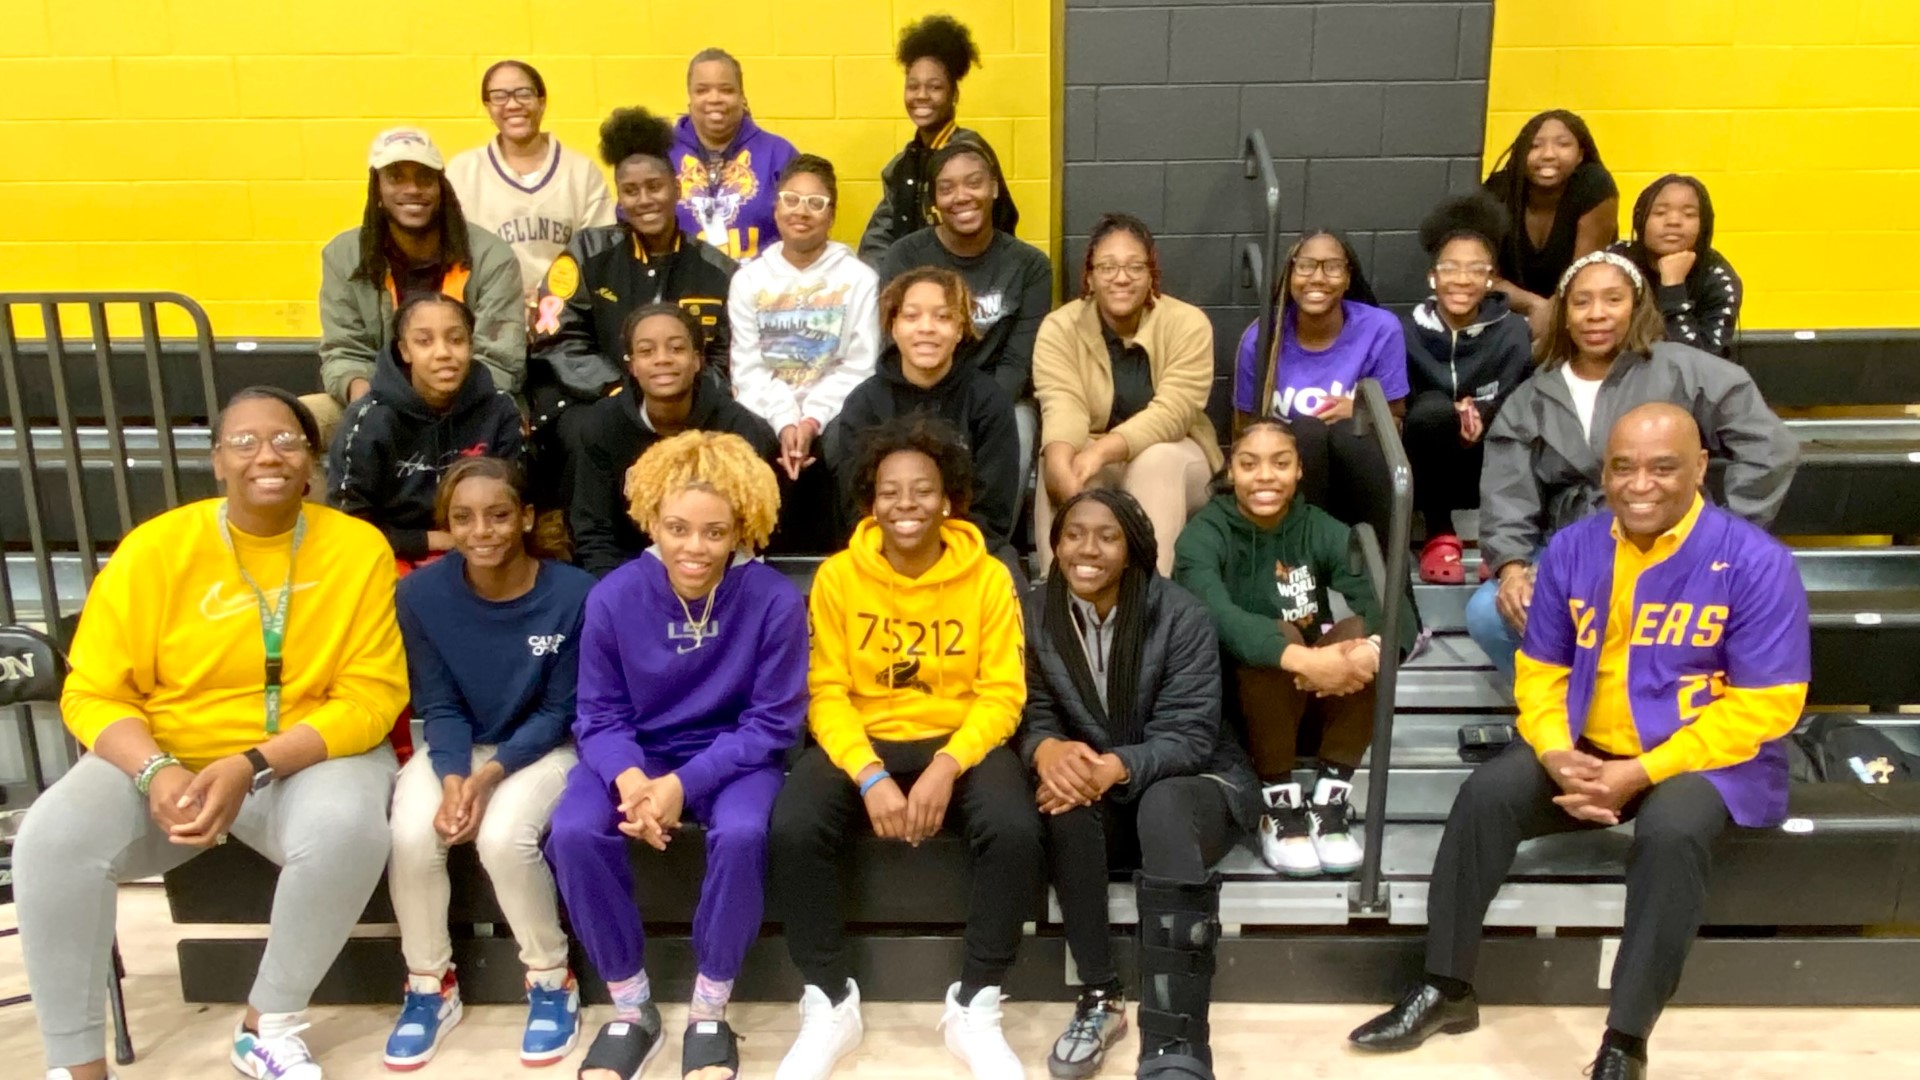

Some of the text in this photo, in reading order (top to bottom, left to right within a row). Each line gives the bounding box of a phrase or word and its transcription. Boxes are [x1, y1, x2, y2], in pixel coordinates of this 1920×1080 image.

[497, 216, 573, 245] ELLNES
[1289, 565, 1311, 584] THE
[1295, 592, 1309, 608] IS
[668, 620, 719, 640] LSU
[857, 612, 966, 658] 75212
